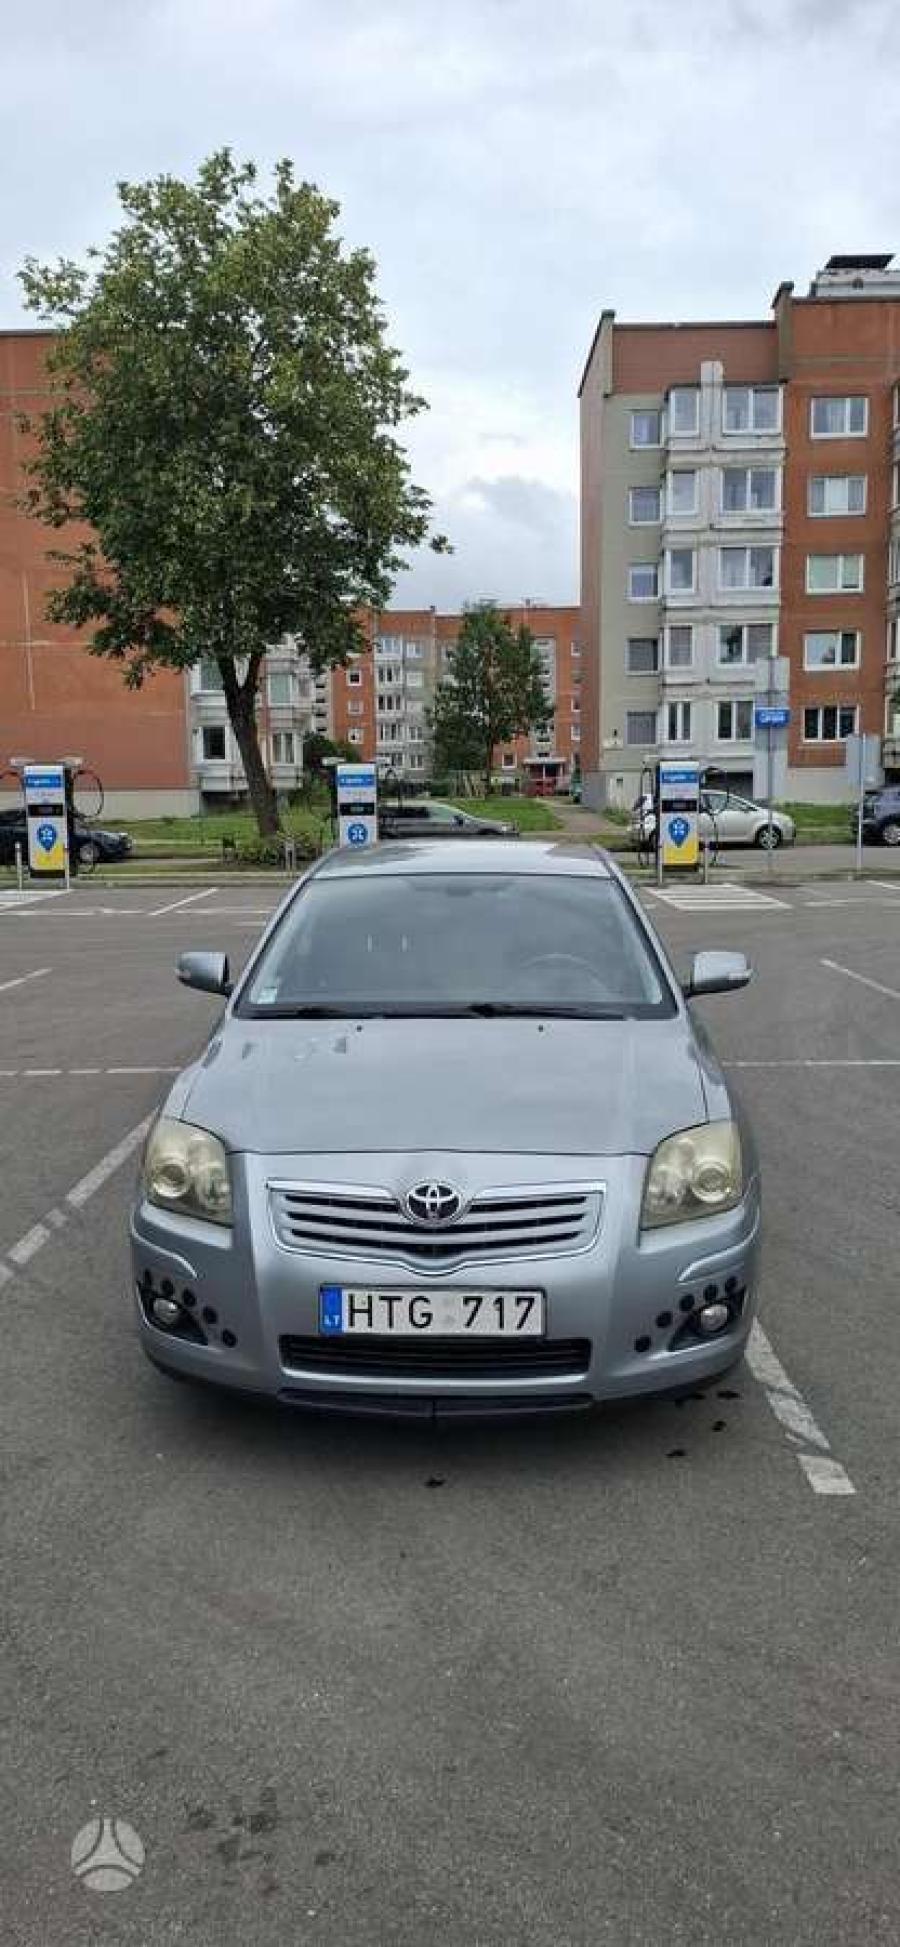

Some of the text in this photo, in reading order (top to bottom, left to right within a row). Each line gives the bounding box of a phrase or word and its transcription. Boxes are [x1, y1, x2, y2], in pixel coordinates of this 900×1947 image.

[323, 1314, 341, 1325] LT
[348, 1293, 536, 1330] HTG 717
